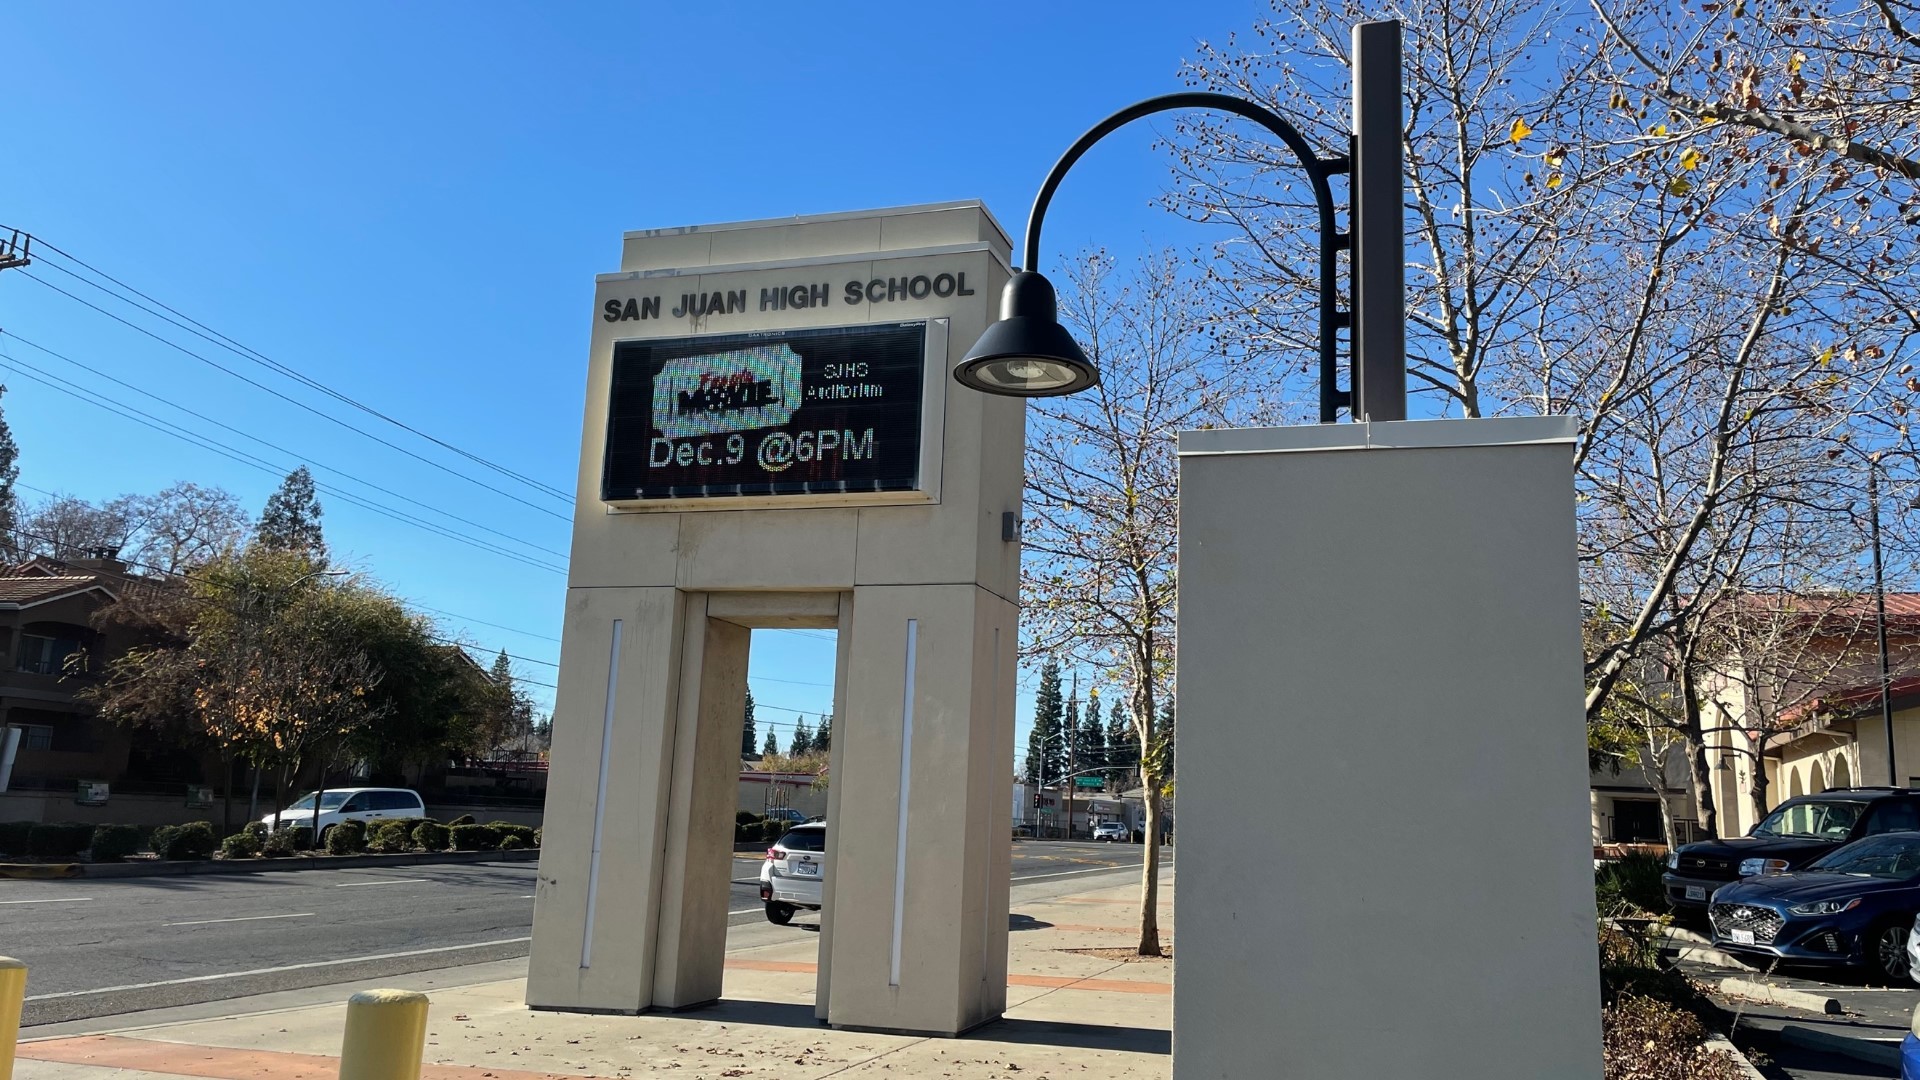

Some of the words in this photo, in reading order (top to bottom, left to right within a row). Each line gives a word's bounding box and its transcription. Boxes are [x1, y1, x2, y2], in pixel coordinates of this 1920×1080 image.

[603, 296, 661, 323] SAN
[672, 289, 747, 319] JUAN
[759, 283, 830, 311] HIGH
[843, 272, 975, 305] SCHOOL
[757, 427, 874, 472] @6PM
